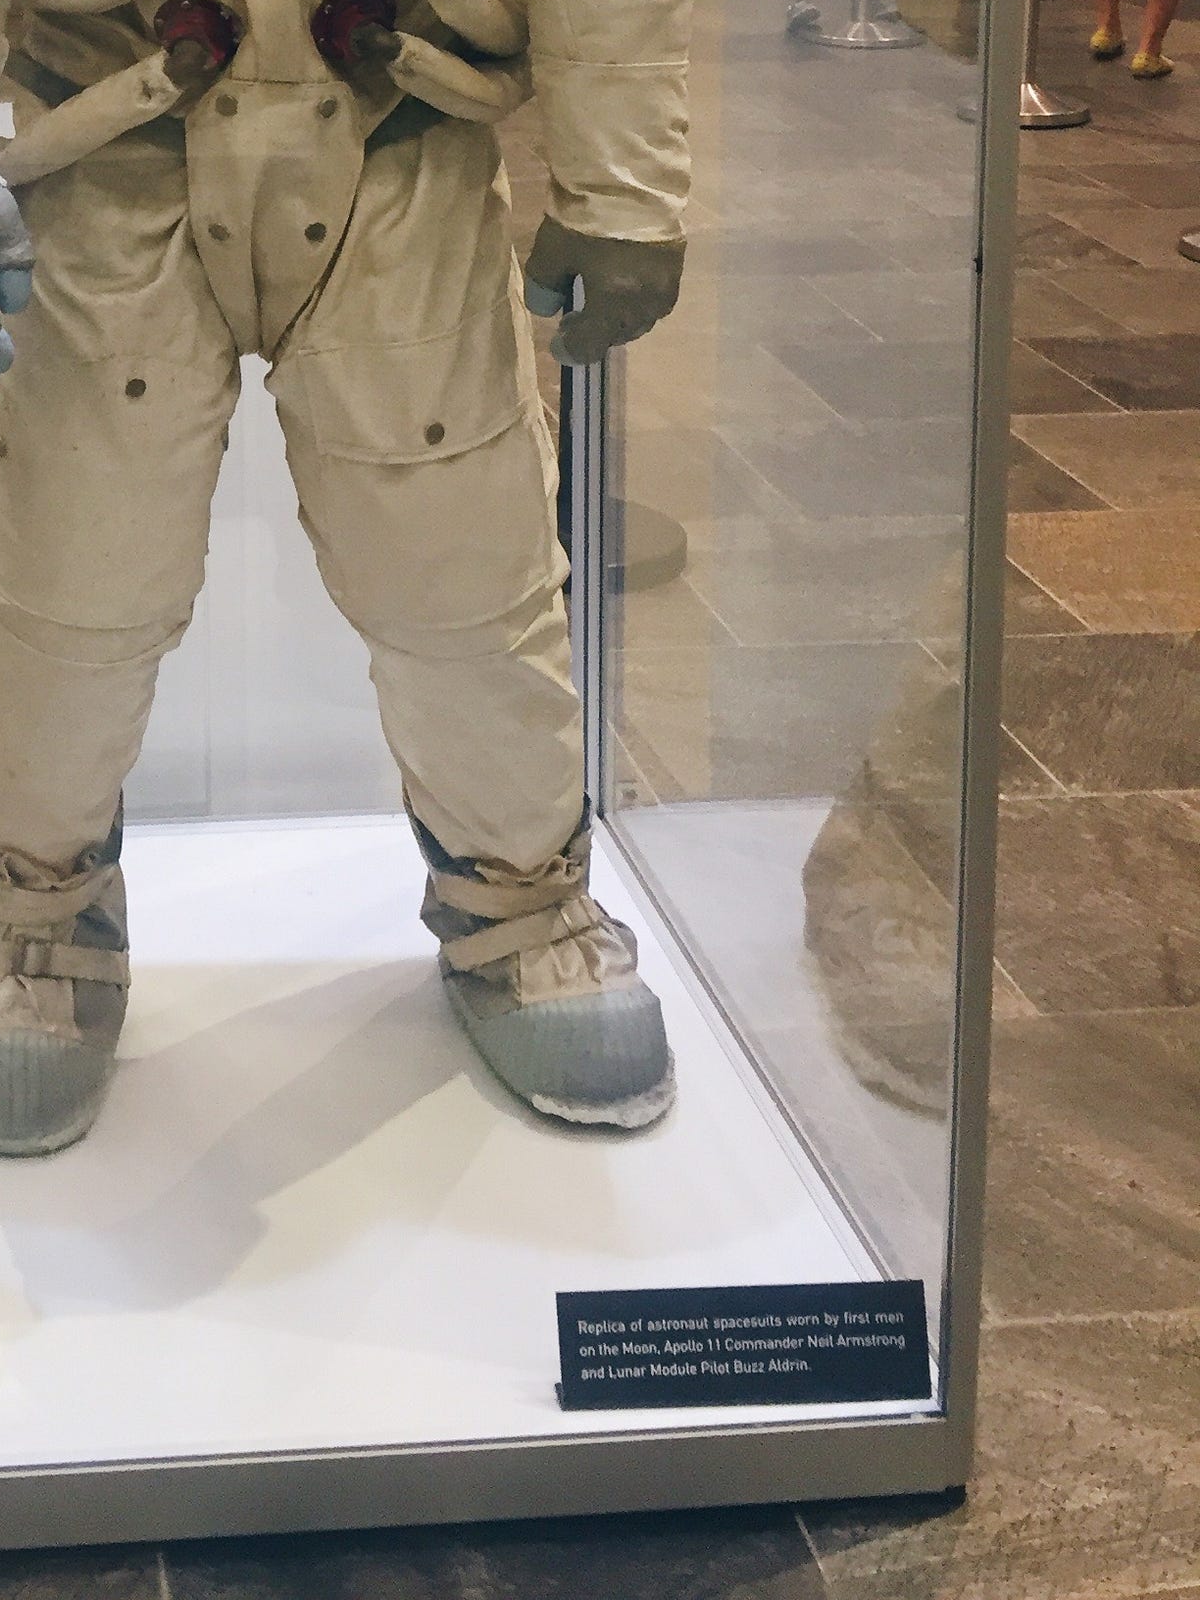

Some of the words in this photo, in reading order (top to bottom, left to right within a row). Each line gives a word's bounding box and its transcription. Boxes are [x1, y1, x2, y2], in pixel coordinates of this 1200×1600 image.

[578, 1320, 626, 1336] Replica
[630, 1318, 643, 1332] of
[647, 1317, 709, 1332] astronaut
[713, 1316, 783, 1331] spacesuits
[786, 1314, 820, 1326] worn
[824, 1312, 839, 1328] by
[844, 1311, 870, 1324] first
[579, 1346, 596, 1357] on
[599, 1342, 619, 1355] the
[623, 1341, 661, 1355] Moon,
[664, 1339, 704, 1355] Apollo
[707, 1338, 721, 1351] 11
[725, 1336, 804, 1351] Commander
[807, 1334, 834, 1348] Neil
[836, 1333, 906, 1349] Armstrong
[581, 1367, 605, 1380] and
[609, 1366, 646, 1379] Lunar
[650, 1363, 697, 1376] Module
[701, 1361, 730, 1375] Pilot
[734, 1359, 765, 1374] Buzz
